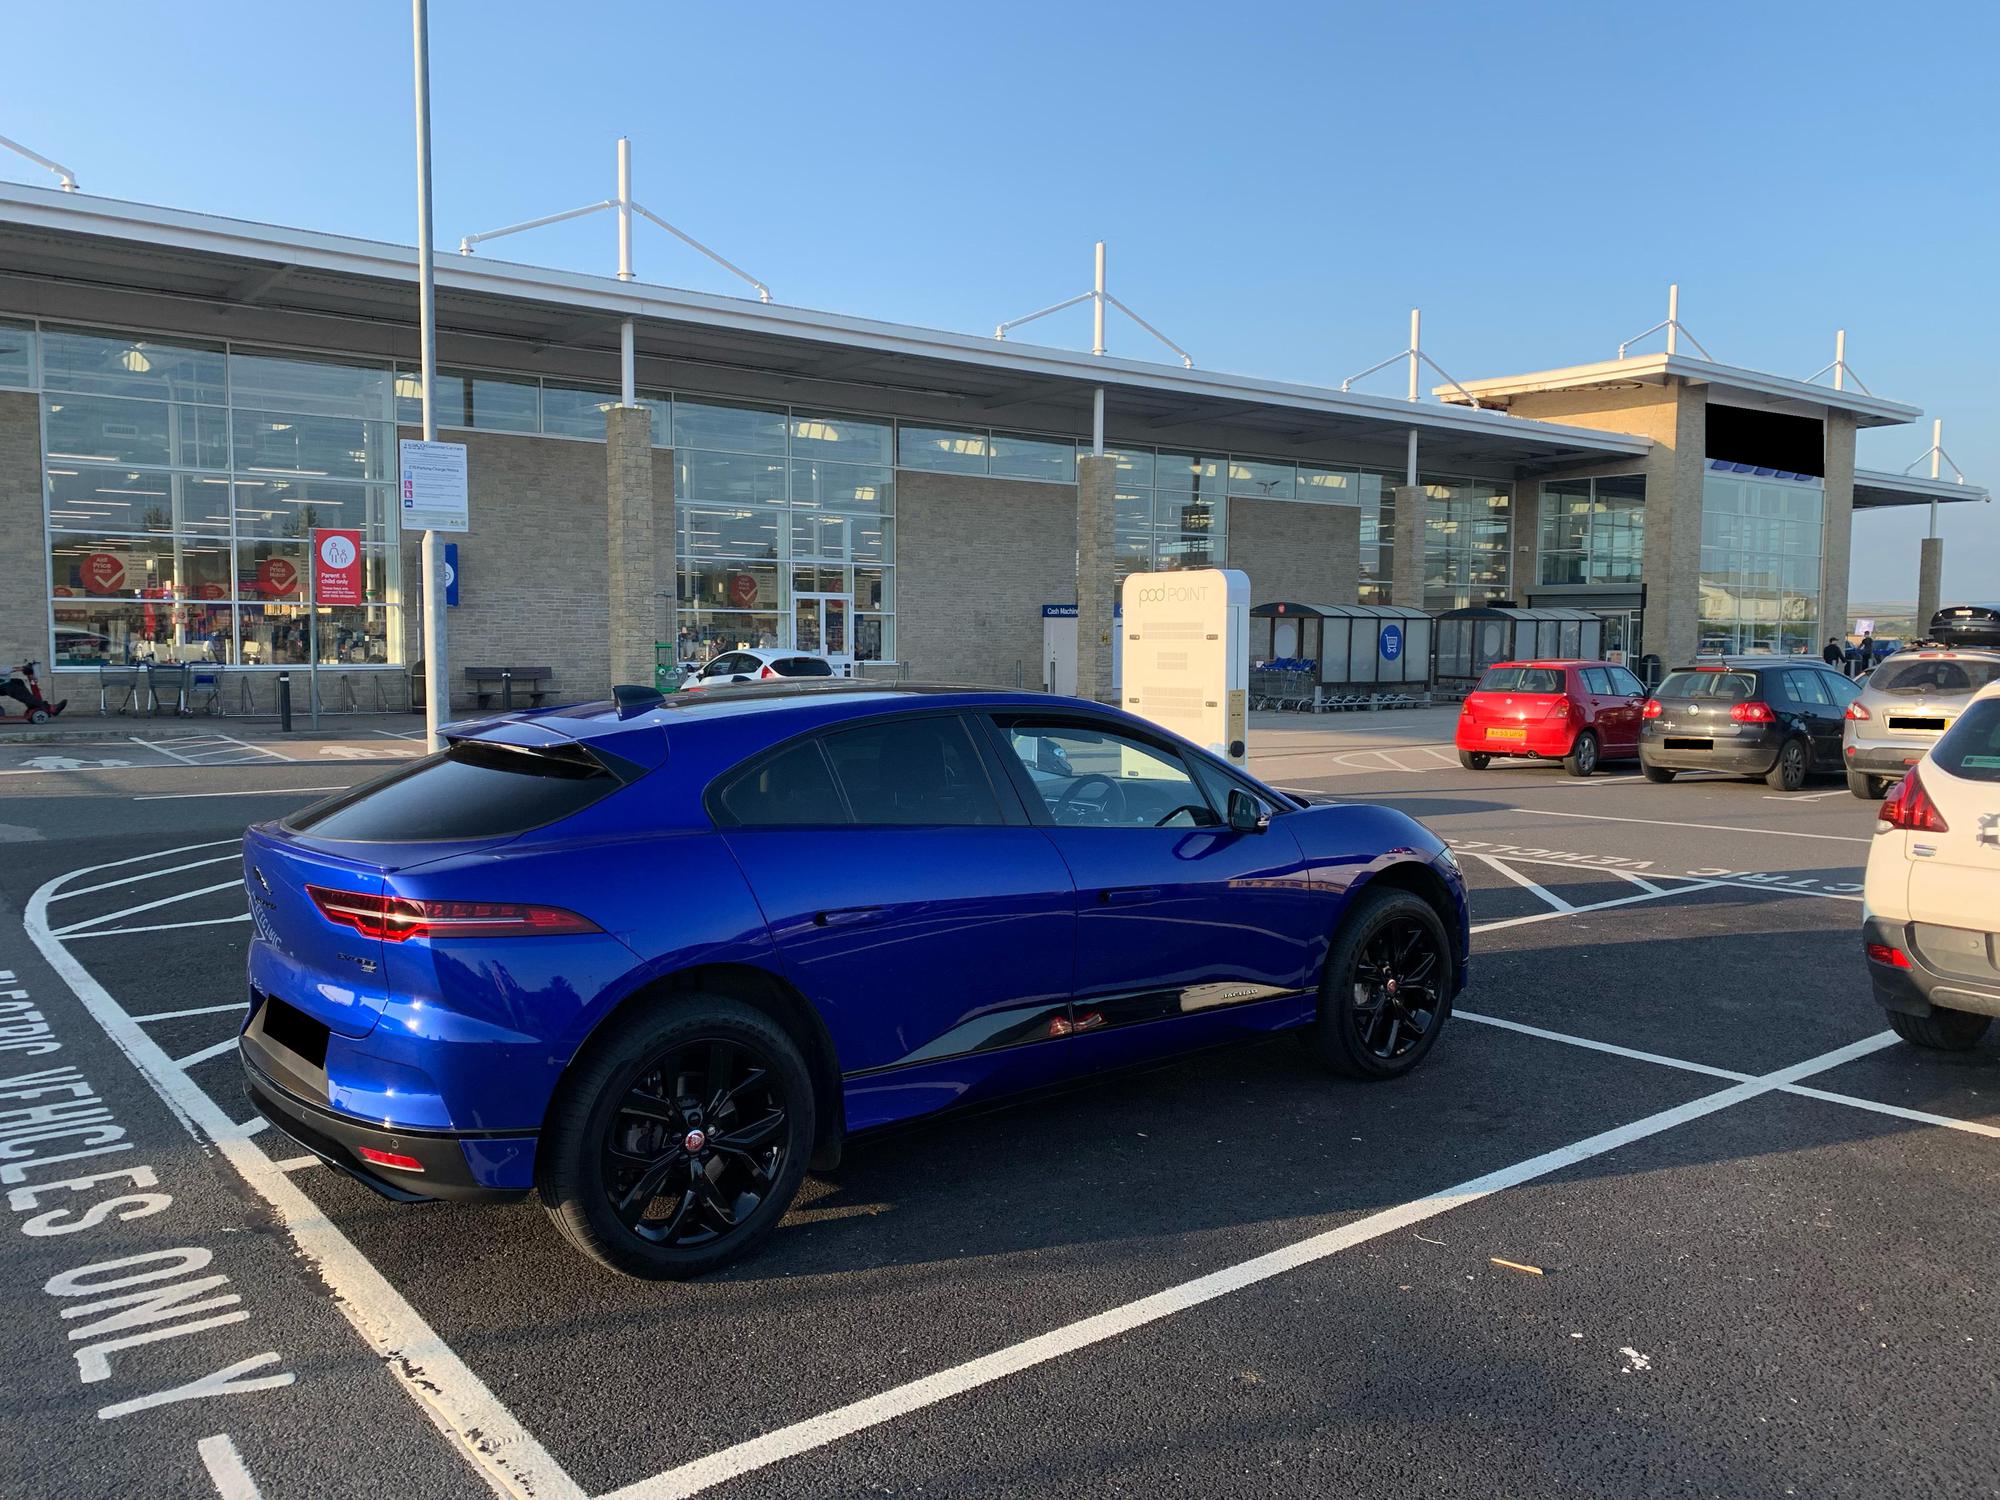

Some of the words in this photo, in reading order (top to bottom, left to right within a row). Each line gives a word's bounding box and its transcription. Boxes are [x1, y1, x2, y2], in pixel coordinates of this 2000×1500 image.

[1138, 582, 1166, 608] pod
[1167, 586, 1209, 602] POINT
[1686, 867, 1864, 892] CTRIC
[0, 1066, 173, 1237] VEHICLES
[41, 1247, 296, 1420] ONLY
